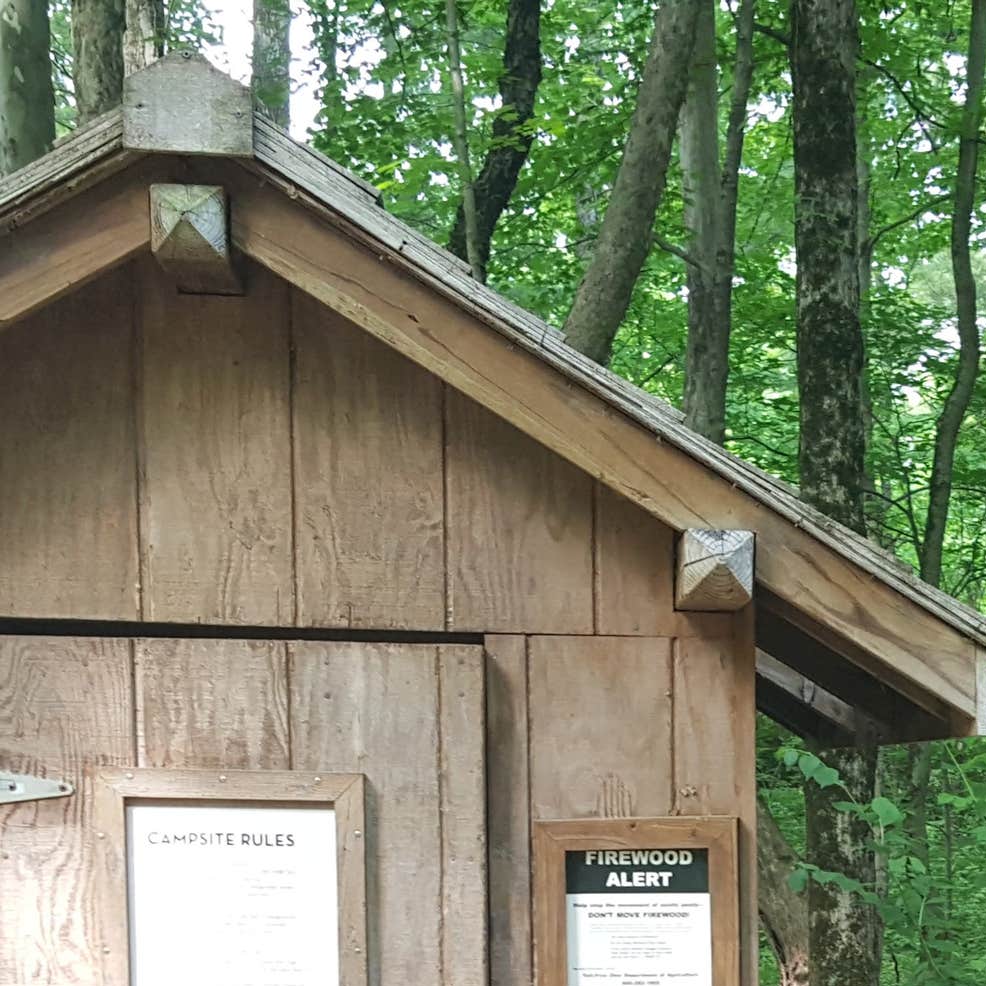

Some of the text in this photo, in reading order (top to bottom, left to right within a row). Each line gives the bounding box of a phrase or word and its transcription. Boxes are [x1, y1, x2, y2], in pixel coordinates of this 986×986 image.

[147, 831, 295, 847] CAMPSITE RULES
[585, 850, 693, 866] FIREWOOD
[605, 871, 673, 887] ALERT
